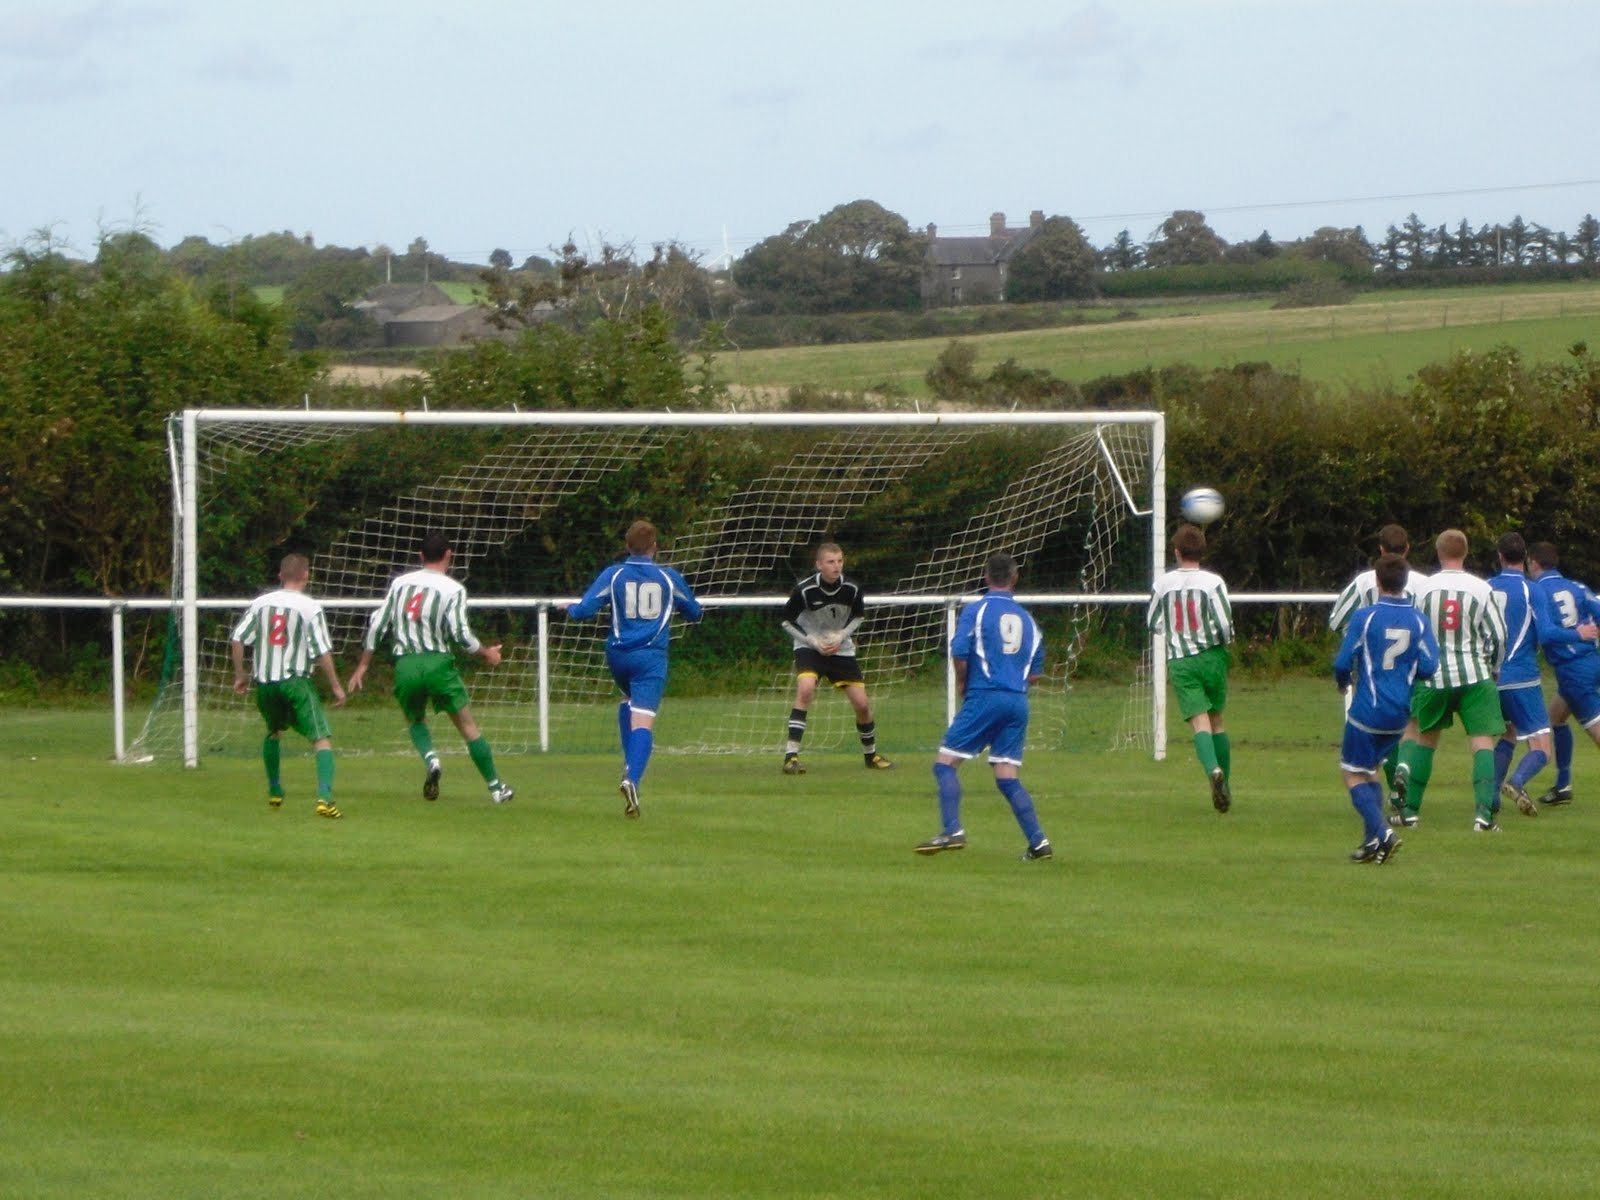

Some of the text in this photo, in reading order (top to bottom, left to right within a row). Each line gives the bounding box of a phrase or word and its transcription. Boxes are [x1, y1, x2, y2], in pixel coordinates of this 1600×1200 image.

[407, 592, 424, 622] 4
[625, 581, 662, 619] 10
[831, 607, 837, 619] 1
[1174, 600, 1198, 632] 11
[1553, 591, 1578, 628] 3
[269, 614, 286, 646] 2
[999, 614, 1023, 654] 9
[1382, 629, 1410, 669] 7
